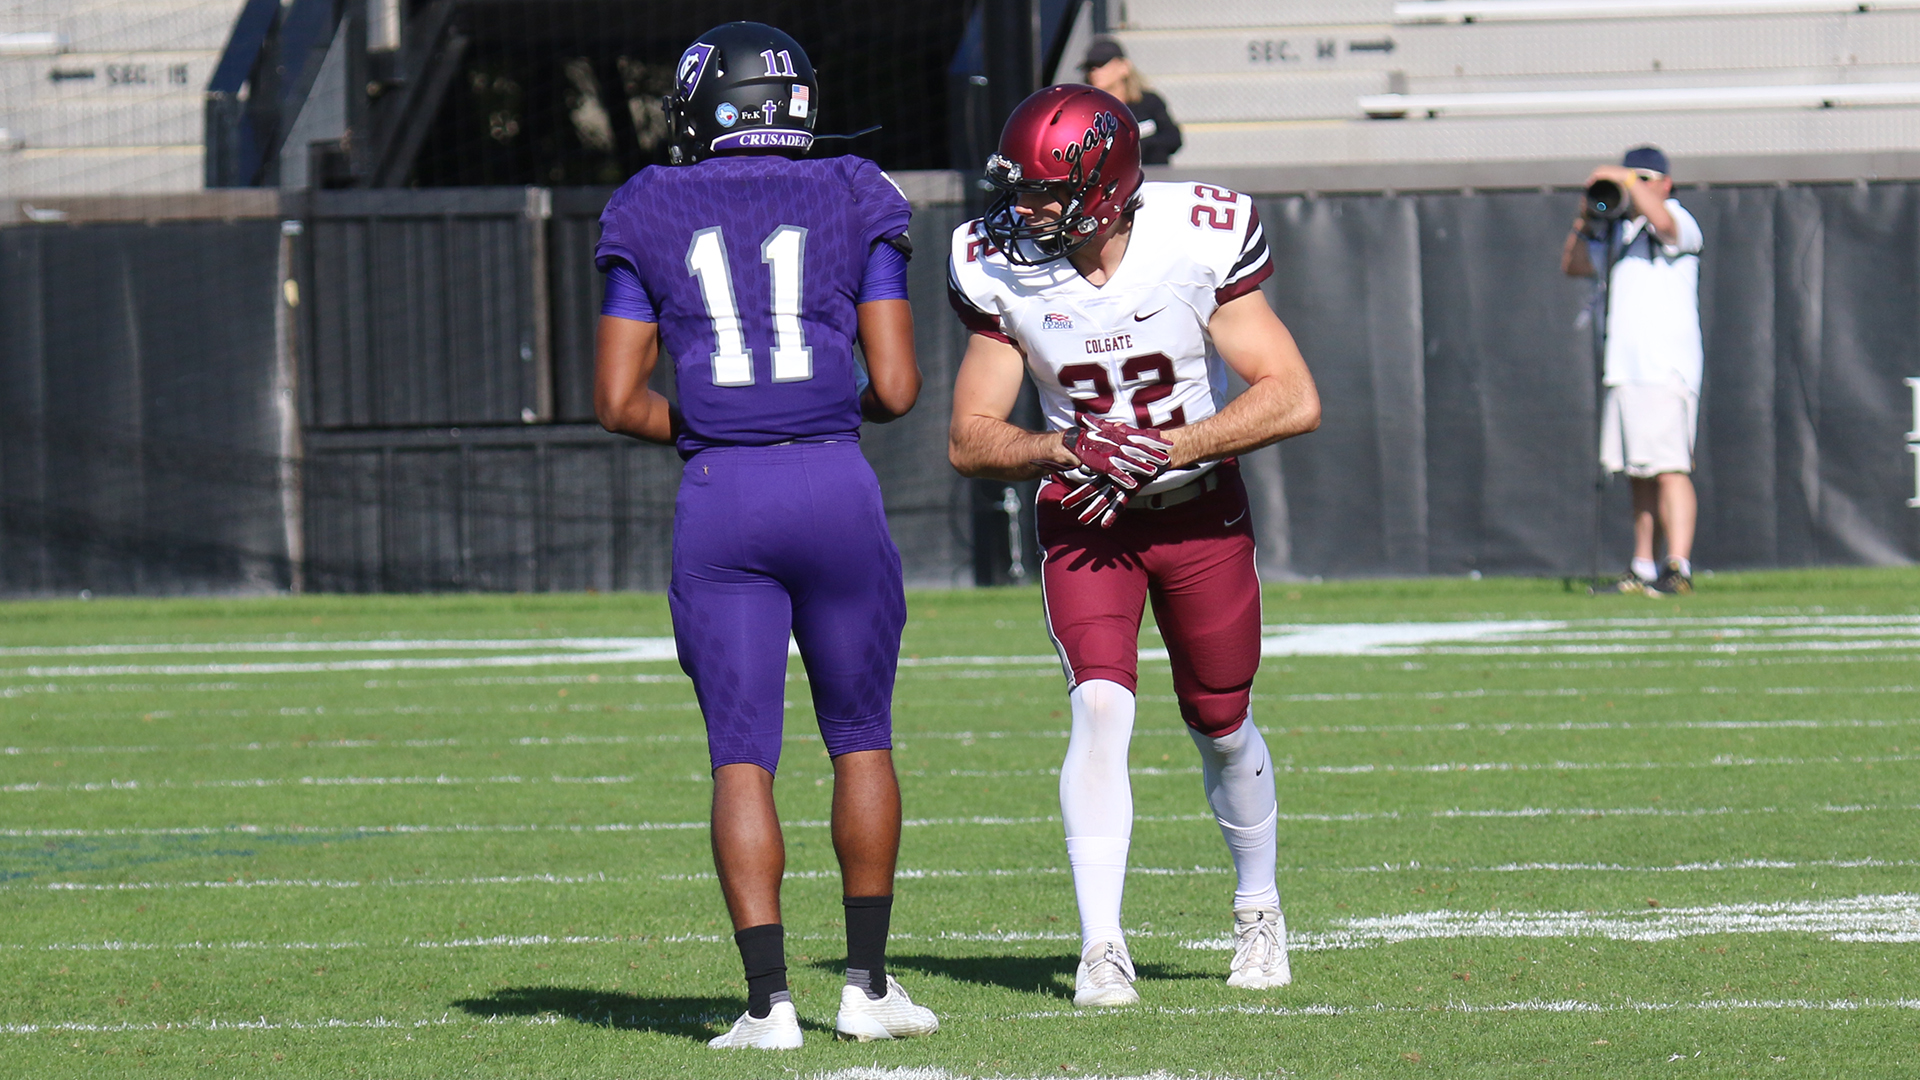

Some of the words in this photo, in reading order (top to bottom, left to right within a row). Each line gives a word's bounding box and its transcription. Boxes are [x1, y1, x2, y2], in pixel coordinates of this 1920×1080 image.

[759, 49, 797, 77] 11
[741, 110, 761, 120] Fr.K
[1190, 184, 1238, 231] 22
[685, 224, 813, 387] 11
[1085, 334, 1133, 354] COLGATE
[1057, 350, 1188, 429] 22
